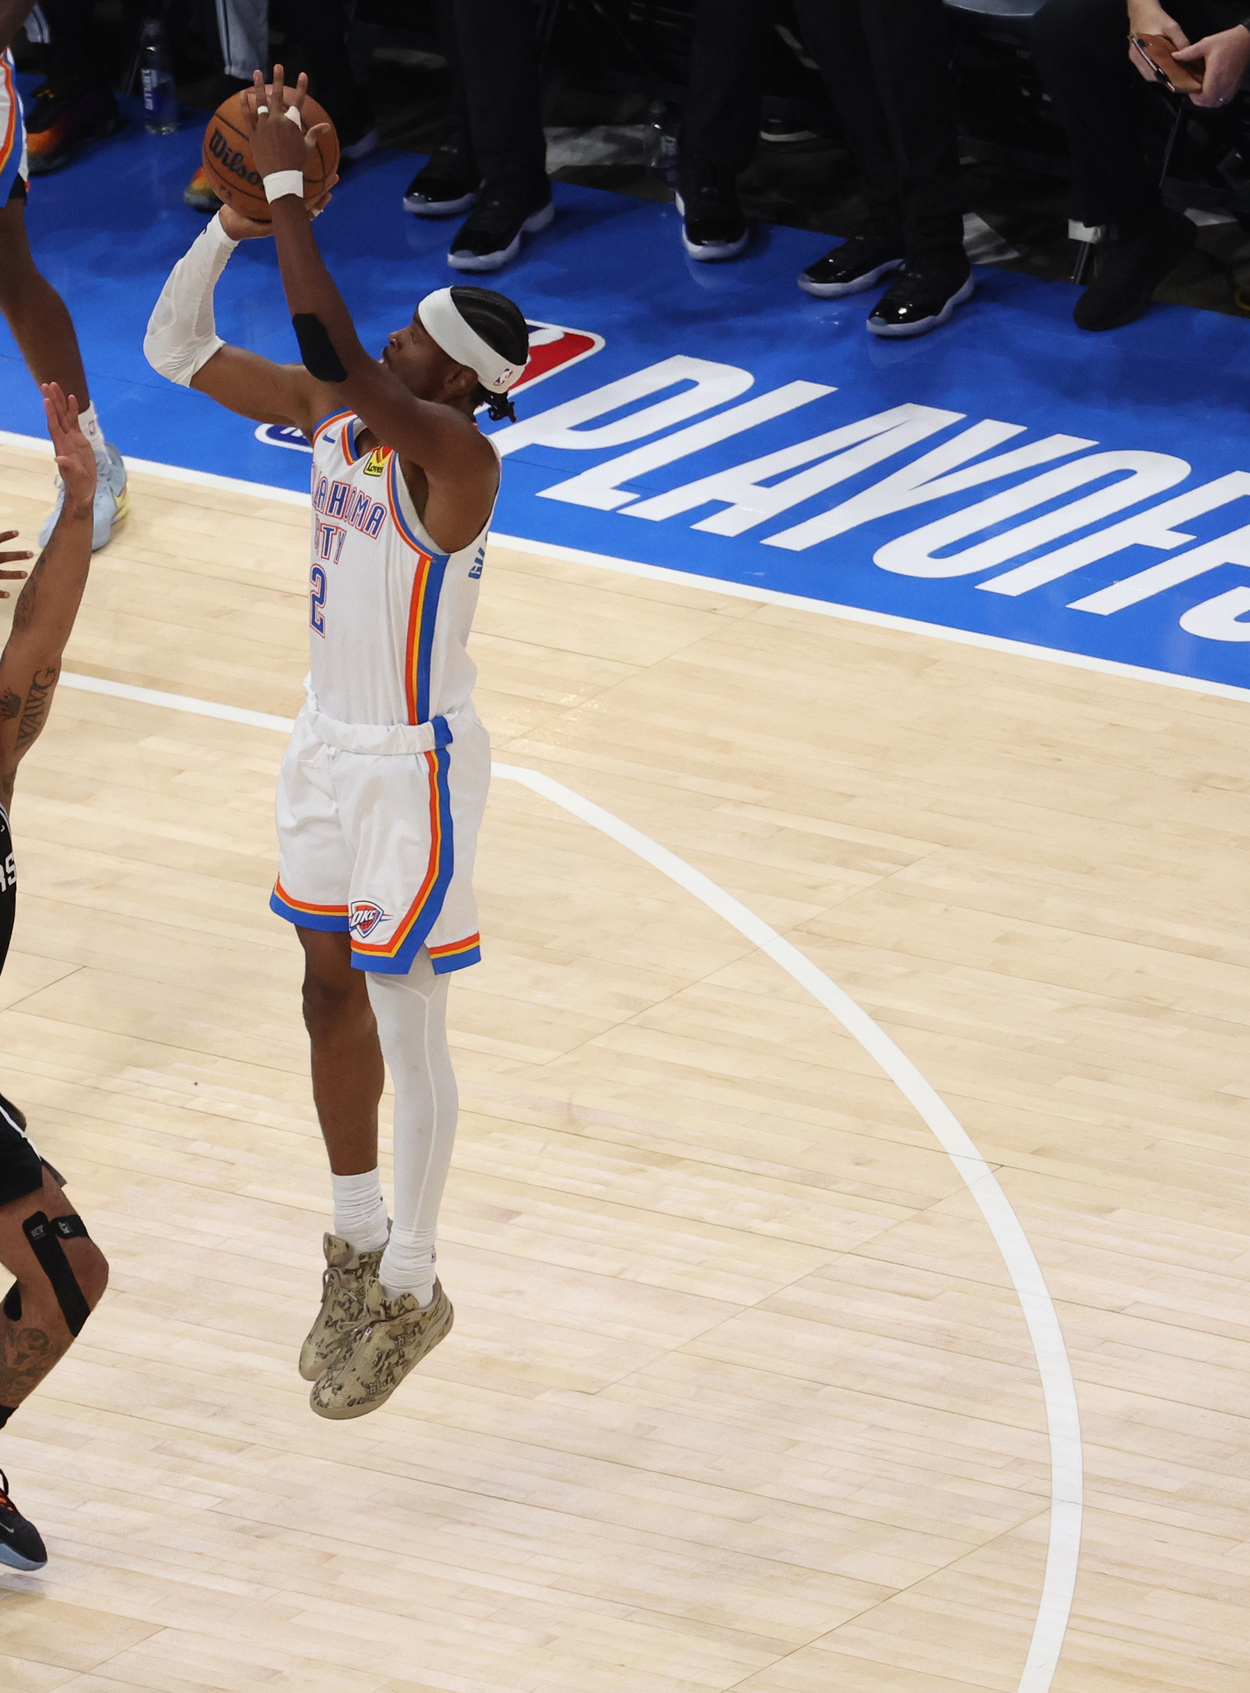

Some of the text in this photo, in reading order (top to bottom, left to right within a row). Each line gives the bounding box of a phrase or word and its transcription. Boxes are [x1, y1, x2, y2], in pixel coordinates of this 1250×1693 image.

[210, 127, 265, 190] Wilso
[309, 563, 328, 639] 2
[350, 910, 376, 927] OKC
